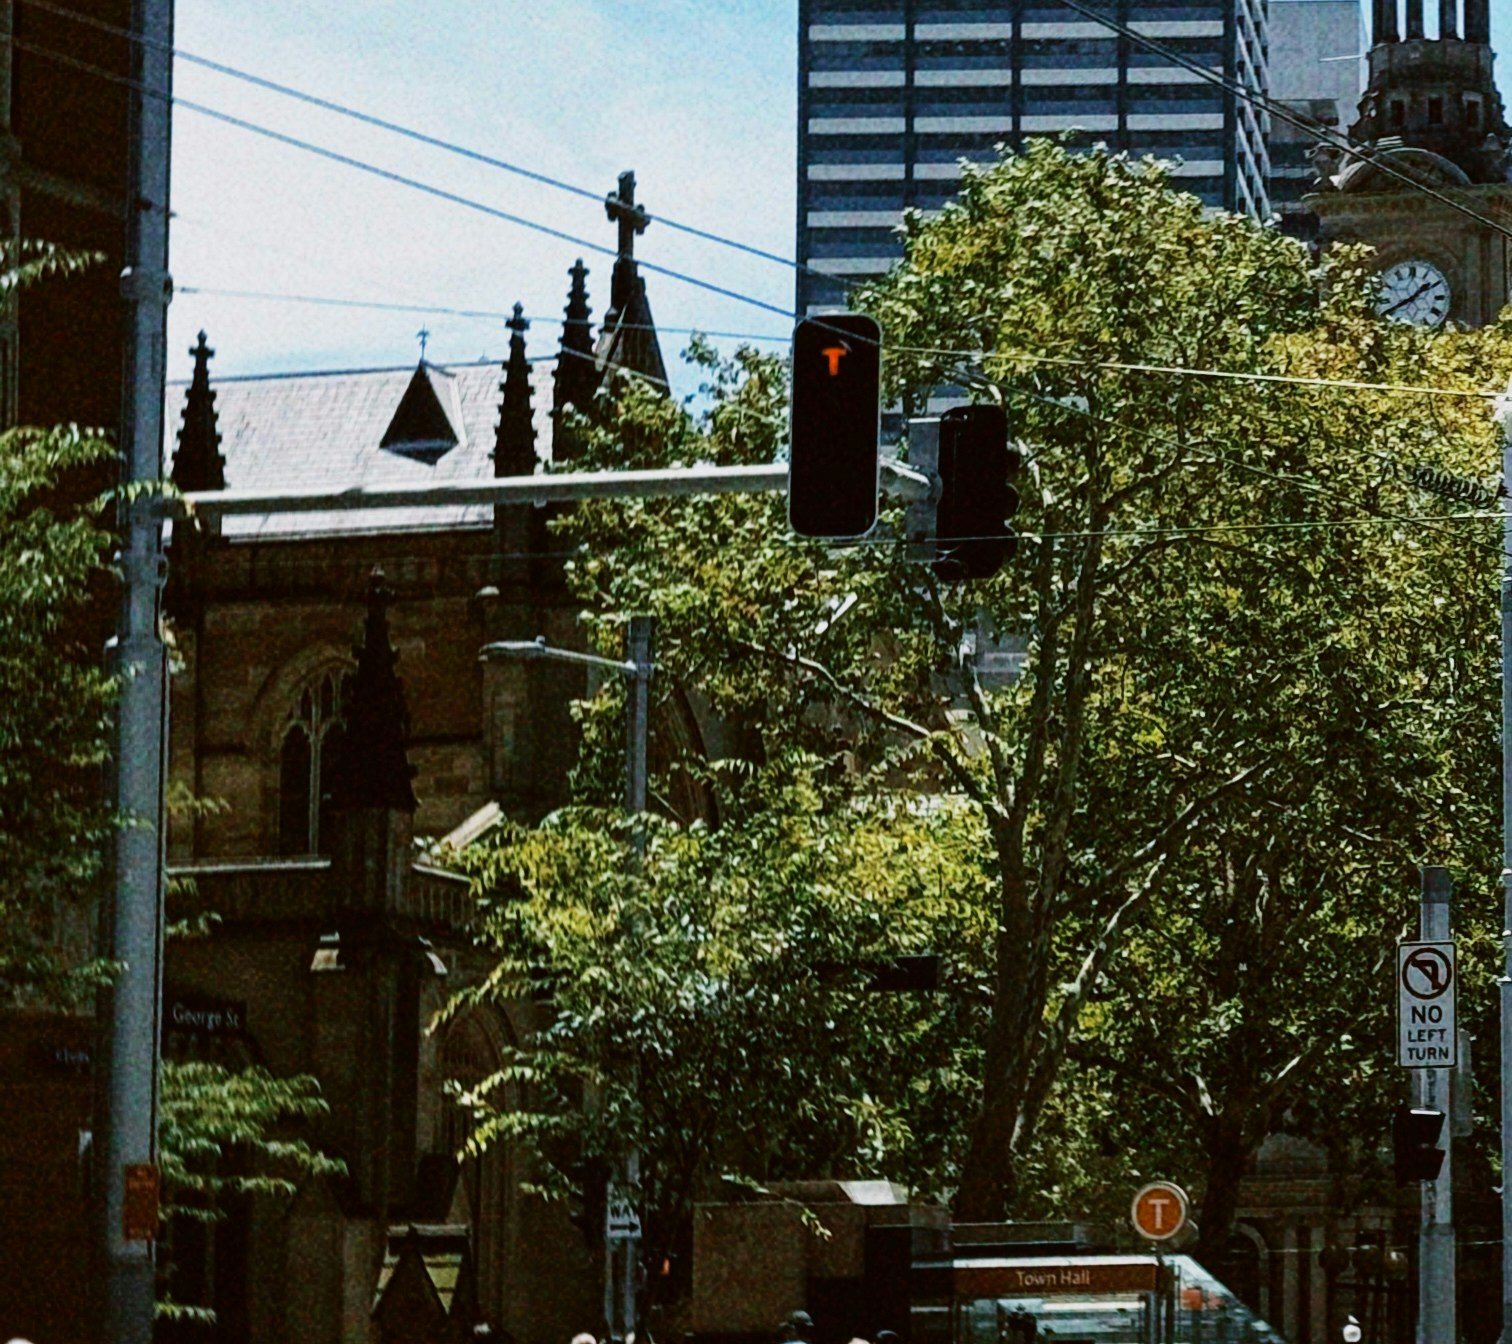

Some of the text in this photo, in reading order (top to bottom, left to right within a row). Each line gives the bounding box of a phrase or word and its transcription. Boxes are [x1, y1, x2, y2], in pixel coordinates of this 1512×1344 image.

[172, 1003, 239, 1030] George St
[1411, 1004, 1443, 1024] NO
[1407, 1028, 1447, 1043] LEFT
[1407, 1047, 1449, 1060] TURN
[1148, 1199, 1170, 1229] T
[1017, 1269, 1090, 1287] Town Hall
